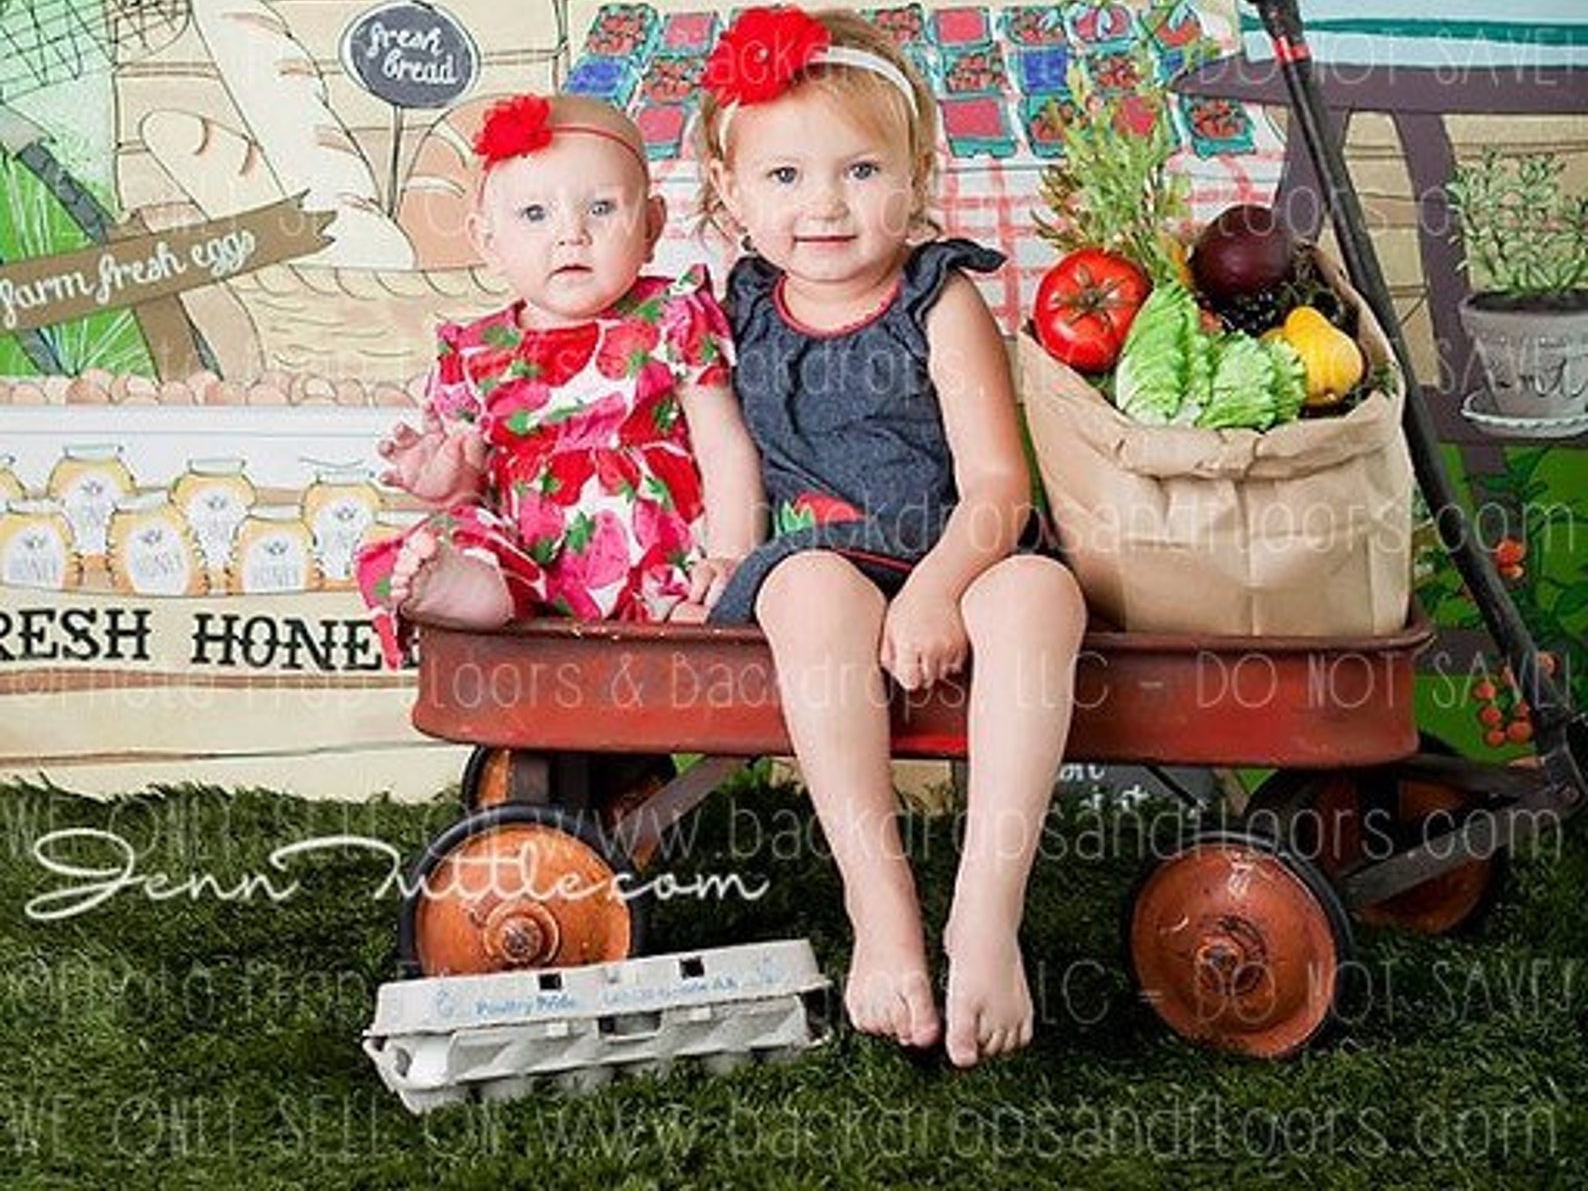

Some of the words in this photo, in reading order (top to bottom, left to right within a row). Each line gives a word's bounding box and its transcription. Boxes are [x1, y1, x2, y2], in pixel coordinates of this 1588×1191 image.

[362, 20, 444, 58] fresh
[382, 48, 459, 85] bread
[0, 270, 95, 329] farm
[96, 240, 188, 303] fresh
[190, 230, 256, 278] eggs
[190, 612, 418, 672] HONE
